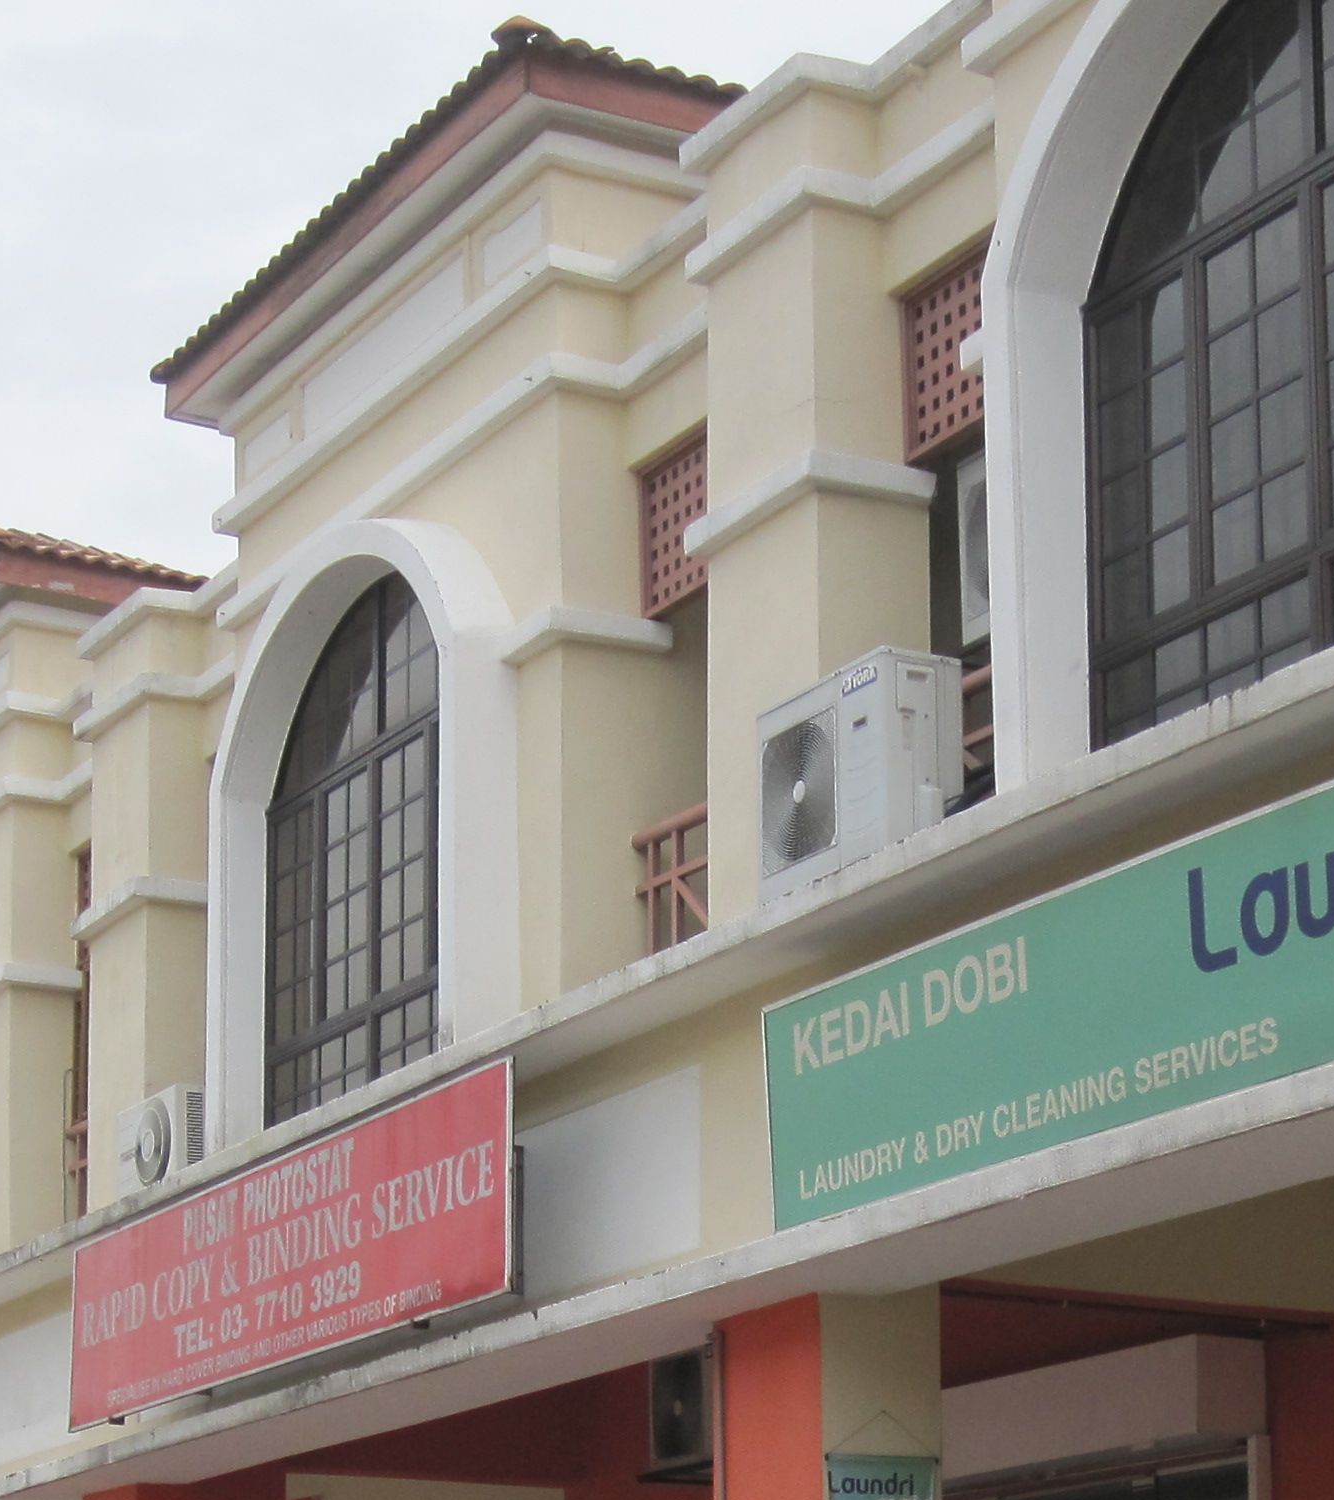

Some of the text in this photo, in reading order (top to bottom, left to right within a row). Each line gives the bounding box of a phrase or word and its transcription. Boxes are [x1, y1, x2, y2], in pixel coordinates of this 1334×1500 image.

[793, 936, 1029, 1075] KEDAI DOBI
[799, 1017, 1279, 1200] LAUNDRY & DRY CLEANING SERVICES
[81, 1139, 495, 1349] RAPID COPY & BINDING SERVICE
[183, 1137, 356, 1255] PUSAT PHOTOSTAT
[174, 1260, 362, 1360] TEL: 03- 7710 3929
[186, 1358, 214, 1382] COVER
[216, 1344, 251, 1371] BINDING
[252, 1337, 270, 1360] AND
[273, 1326, 305, 1353] OTHER
[306, 1312, 348, 1341] VARIOUS
[350, 1299, 381, 1327] TYPES
[383, 1294, 397, 1318] OF
[399, 1279, 442, 1312] BINDING
[828, 1471, 915, 1496] Laundri
